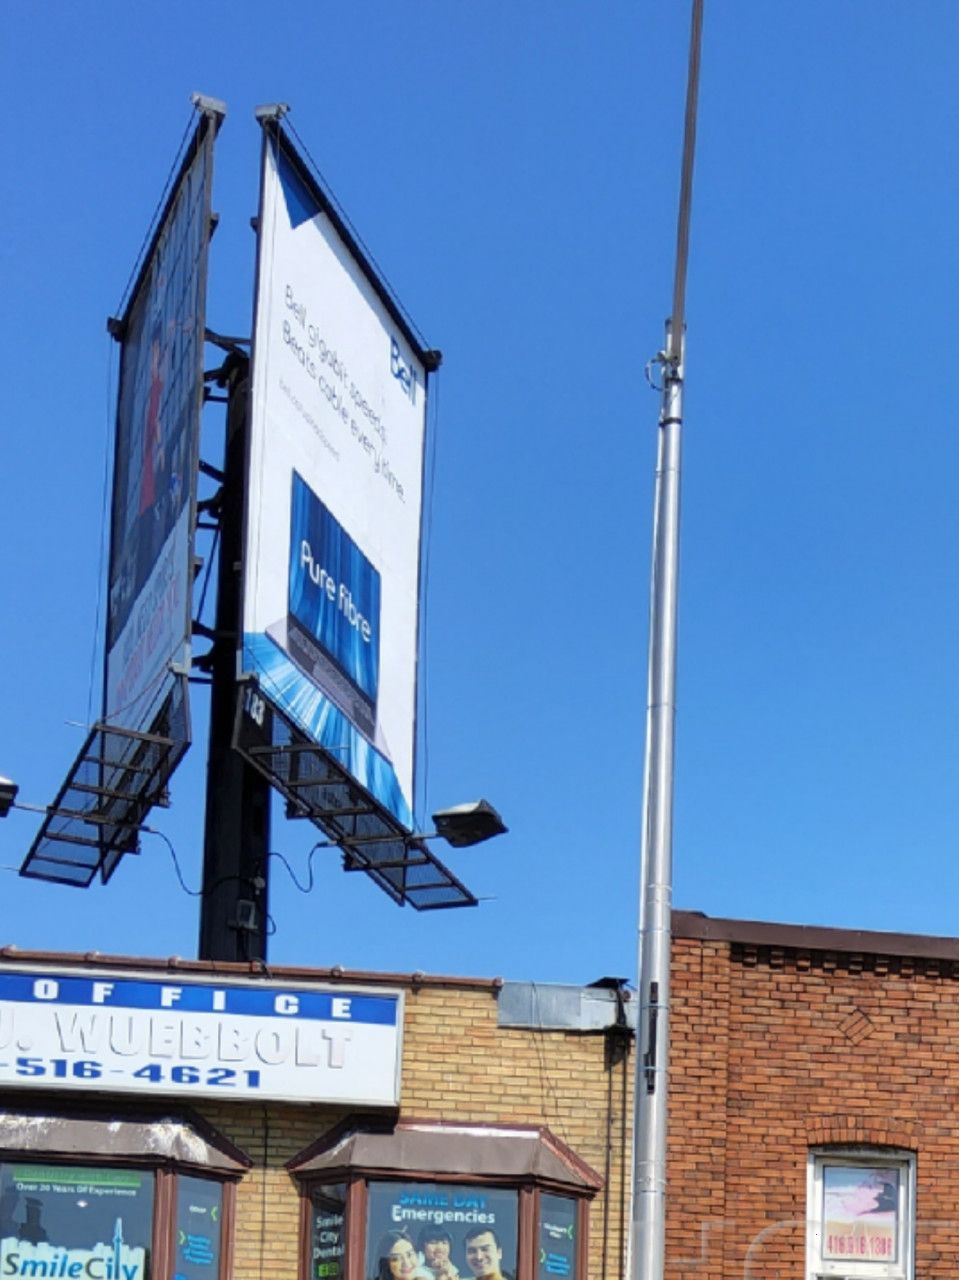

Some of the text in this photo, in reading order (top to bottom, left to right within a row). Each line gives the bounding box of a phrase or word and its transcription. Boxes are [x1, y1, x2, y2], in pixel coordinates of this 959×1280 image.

[285, 285, 307, 329] Bell
[308, 325, 348, 389] gigabit
[390, 335, 417, 406] Bell
[283, 320, 317, 379] Beats
[318, 375, 349, 425] cable
[350, 419, 381, 474] every
[301, 539, 372, 643] Pure fibre
[33, 978, 352, 1019] OFFICE
[54, 1010, 353, 1069] WUEBBOLT
[16, 1182, 38, 1192] Over
[52, 1184, 75, 1195] Years
[88, 1186, 137, 1198] Experience
[400, 1191, 448, 1207] SAME
[316, 1214, 344, 1229] Smile
[392, 1205, 496, 1224] Emergencies
[313, 1244, 345, 1260] Dental
[320, 1230, 339, 1246] City
